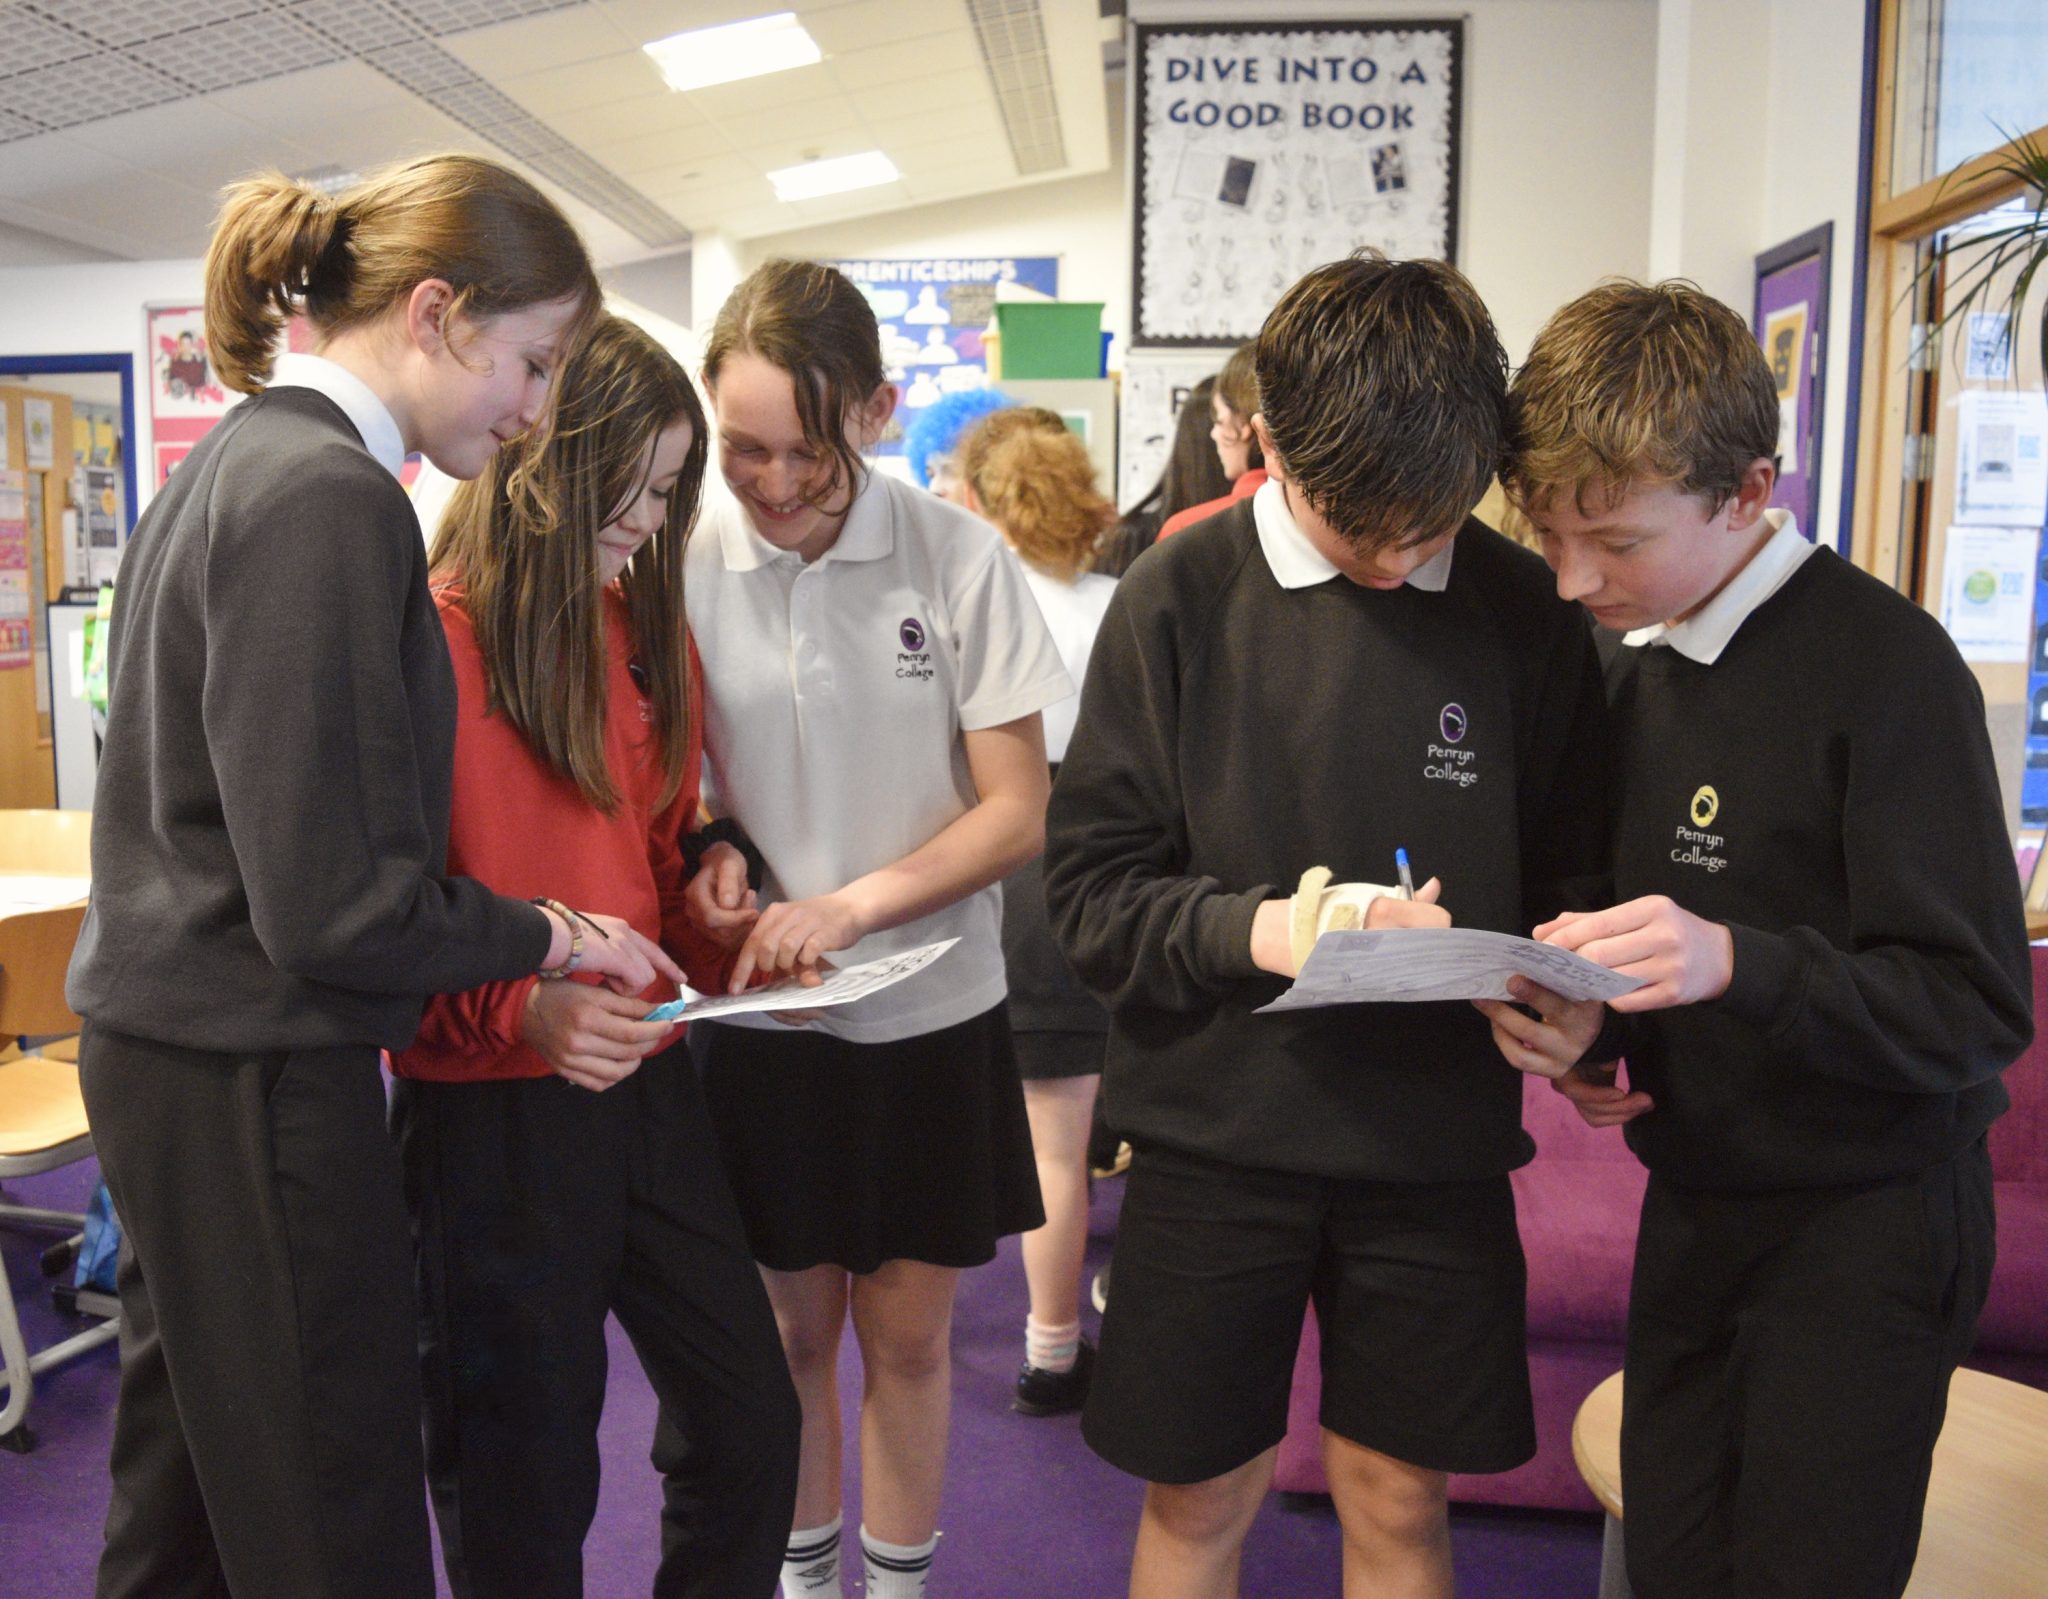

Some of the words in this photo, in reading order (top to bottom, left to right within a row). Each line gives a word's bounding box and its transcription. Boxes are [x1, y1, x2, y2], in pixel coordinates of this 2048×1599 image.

[1166, 57, 1259, 84] DIVE
[1278, 57, 1378, 84] INTO
[1400, 61, 1427, 85] A
[1168, 99, 1281, 129] GOOD
[1303, 102, 1414, 130] BOOK
[834, 259, 1017, 282] PRENTICESHIPS
[897, 653, 931, 665] Penryn
[895, 664, 934, 681] College
[1427, 744, 1475, 766] Penryn
[1423, 762, 1478, 787] College
[1676, 825, 1724, 850] Penryn
[1670, 845, 1727, 873] College
